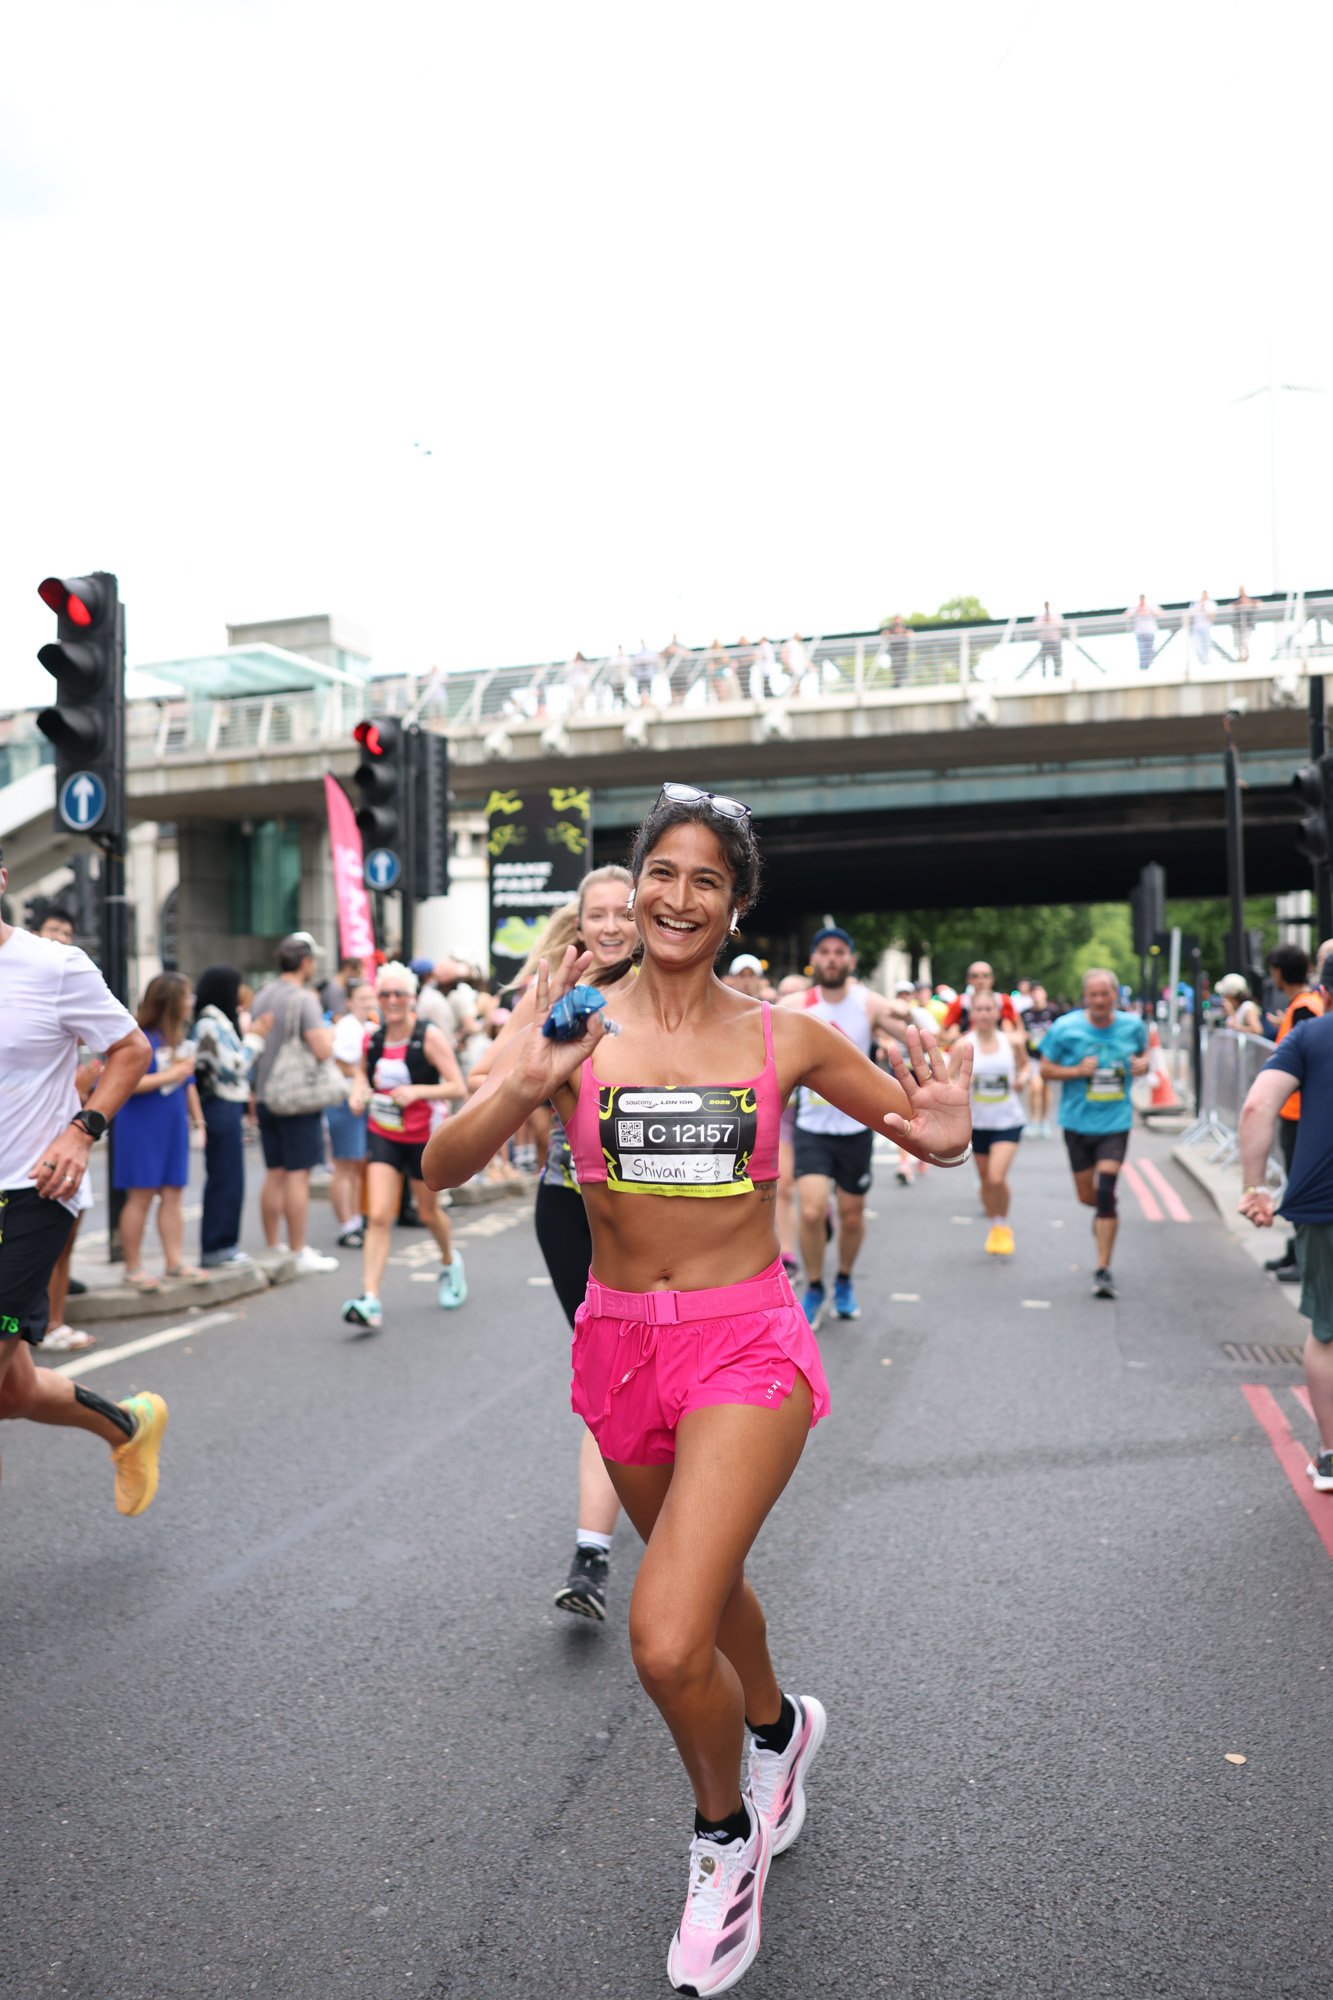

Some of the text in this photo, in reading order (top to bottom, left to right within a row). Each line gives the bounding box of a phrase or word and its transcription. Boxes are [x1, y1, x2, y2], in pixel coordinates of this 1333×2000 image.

[648, 1124, 734, 1143] C 12157
[631, 1158, 686, 1180] Shivani
